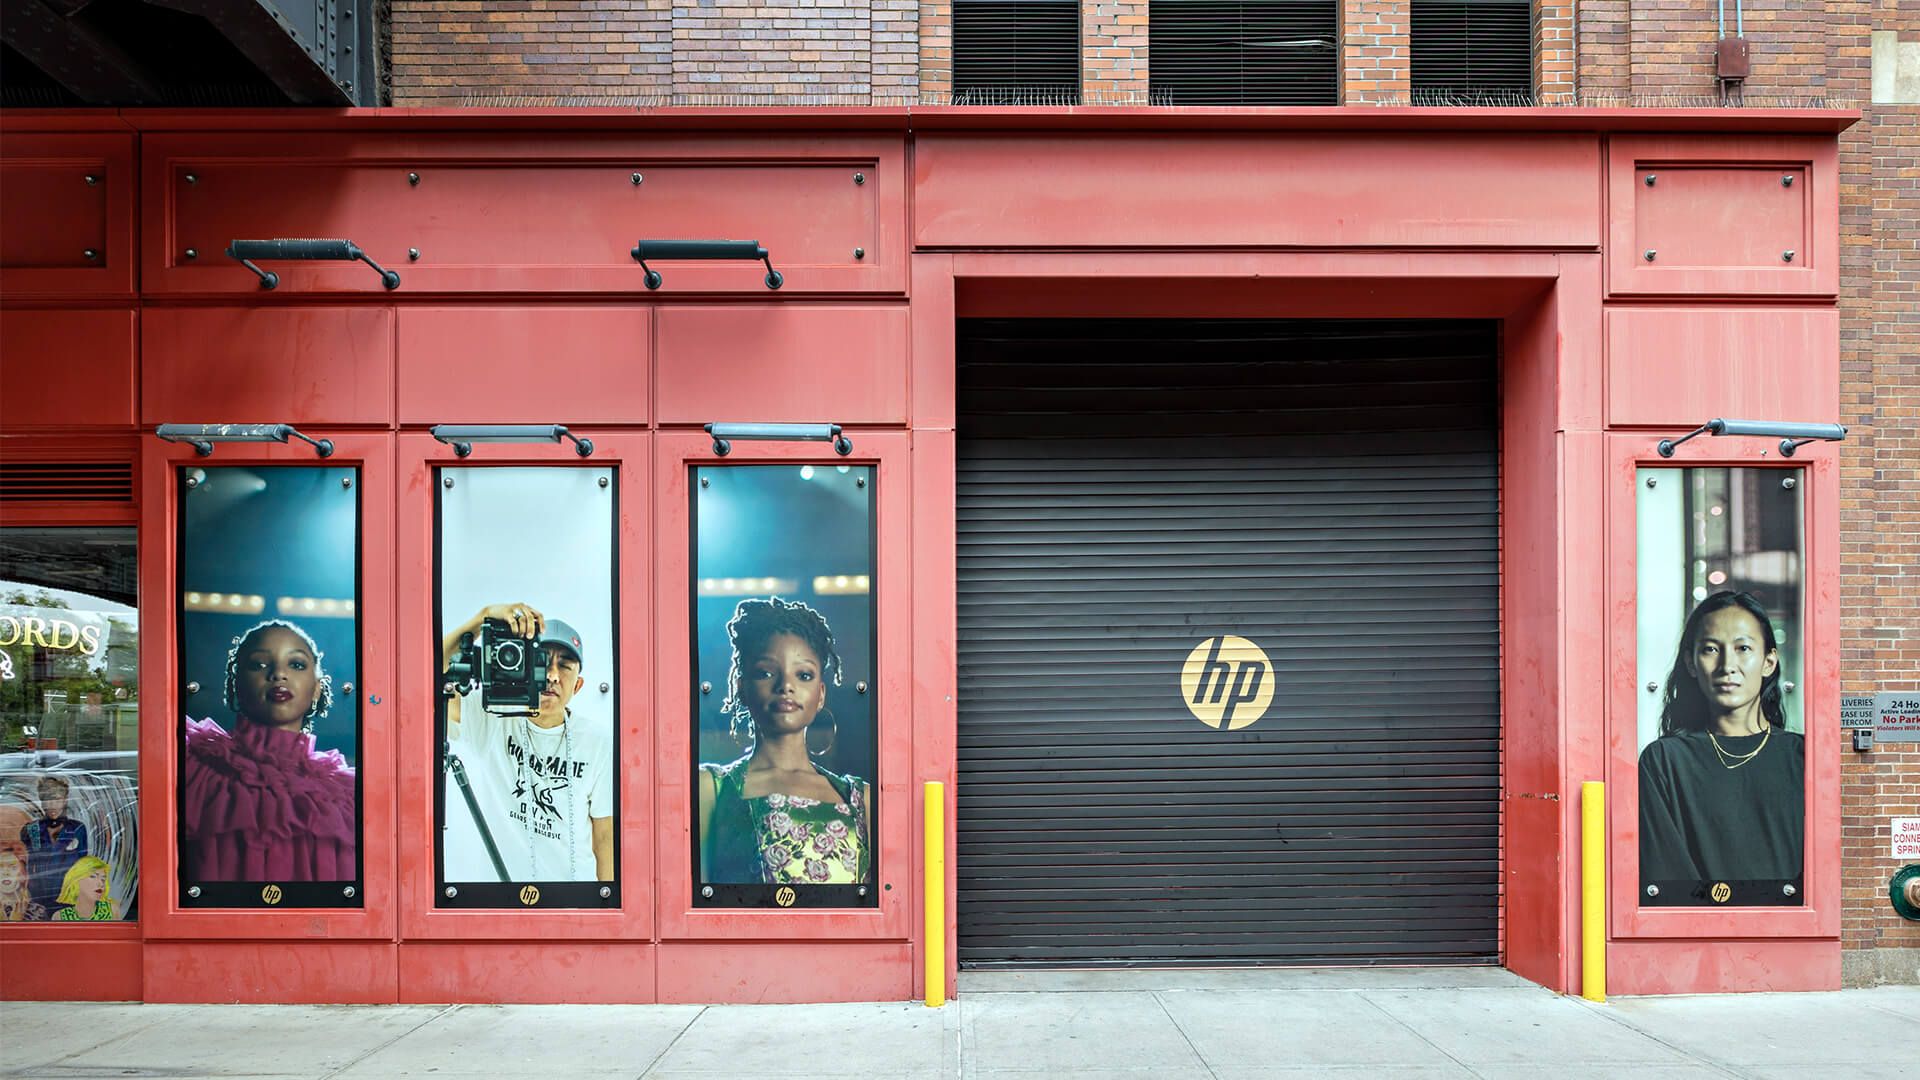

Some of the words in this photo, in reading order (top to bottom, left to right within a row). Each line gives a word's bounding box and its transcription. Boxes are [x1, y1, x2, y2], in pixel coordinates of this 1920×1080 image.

[1190, 635, 1267, 730] hp
[1891, 700, 1903, 709] 24
[1906, 700, 1920, 709] Ho
[1883, 715, 1897, 724] No
[264, 885, 280, 904] hp
[522, 885, 538, 905] hp
[778, 887, 794, 906] hp
[1713, 883, 1729, 902] hp
